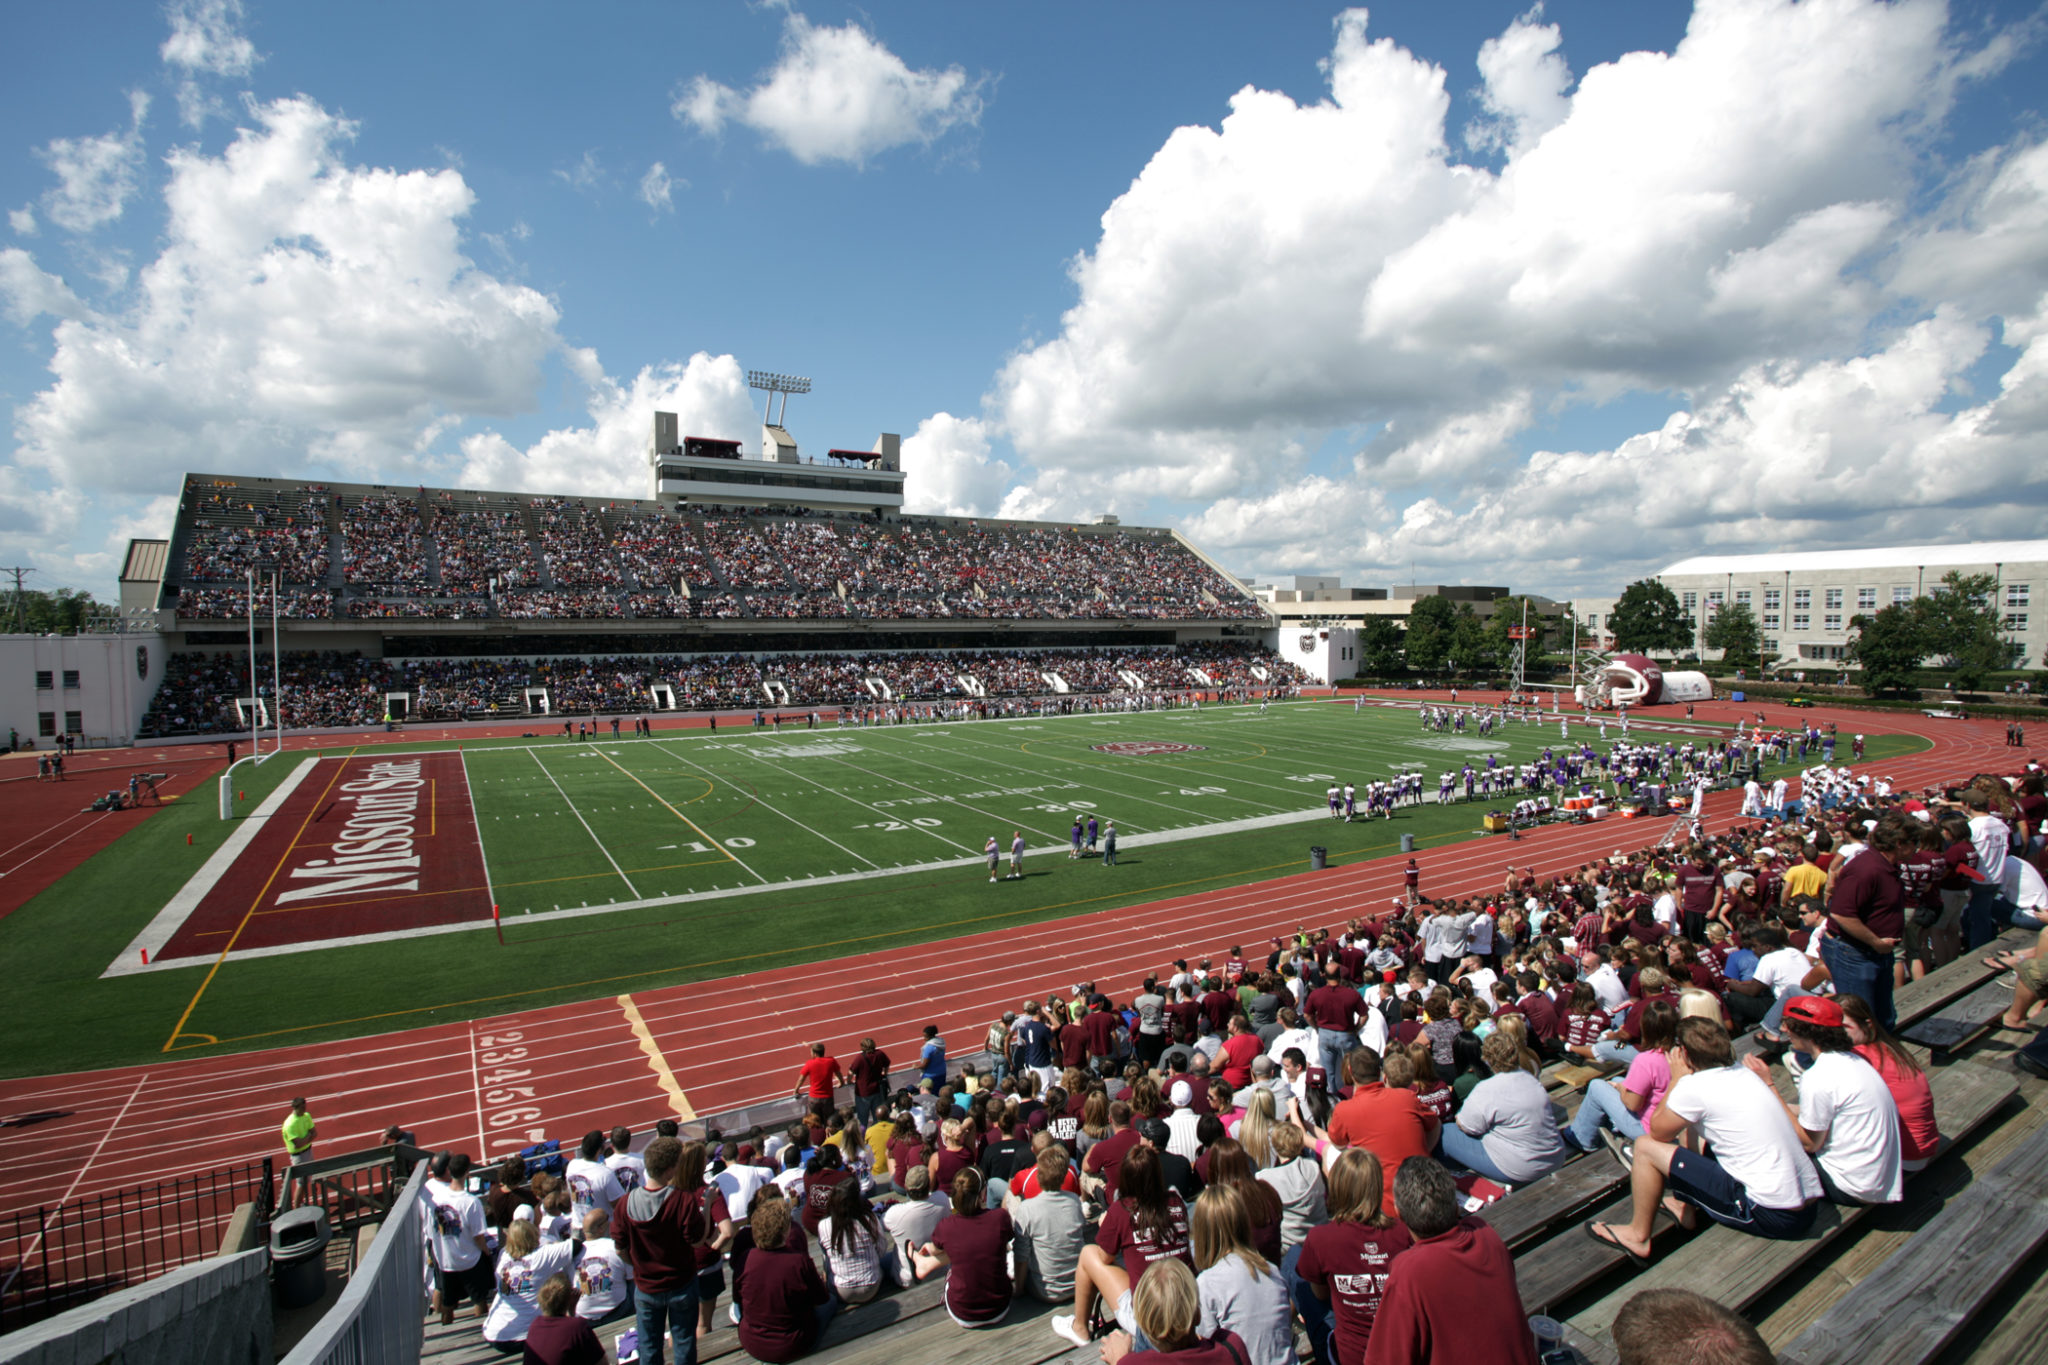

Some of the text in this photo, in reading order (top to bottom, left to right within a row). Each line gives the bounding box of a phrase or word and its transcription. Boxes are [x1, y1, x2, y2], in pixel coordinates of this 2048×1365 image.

[1287, 773, 1336, 783] 50
[1179, 785, 1228, 797] 40
[1036, 801, 1098, 813] 30
[274, 759, 426, 906] Missouri State
[874, 817, 943, 832] 20
[682, 837, 757, 854] 10
[480, 1031, 524, 1047] 2
[481, 1047, 529, 1064] 3
[483, 1068, 532, 1085] 4
[485, 1086, 536, 1104] 5
[488, 1106, 542, 1127] 6
[491, 1127, 547, 1147] 7
[1360, 1252, 1389, 1261] Missouri
